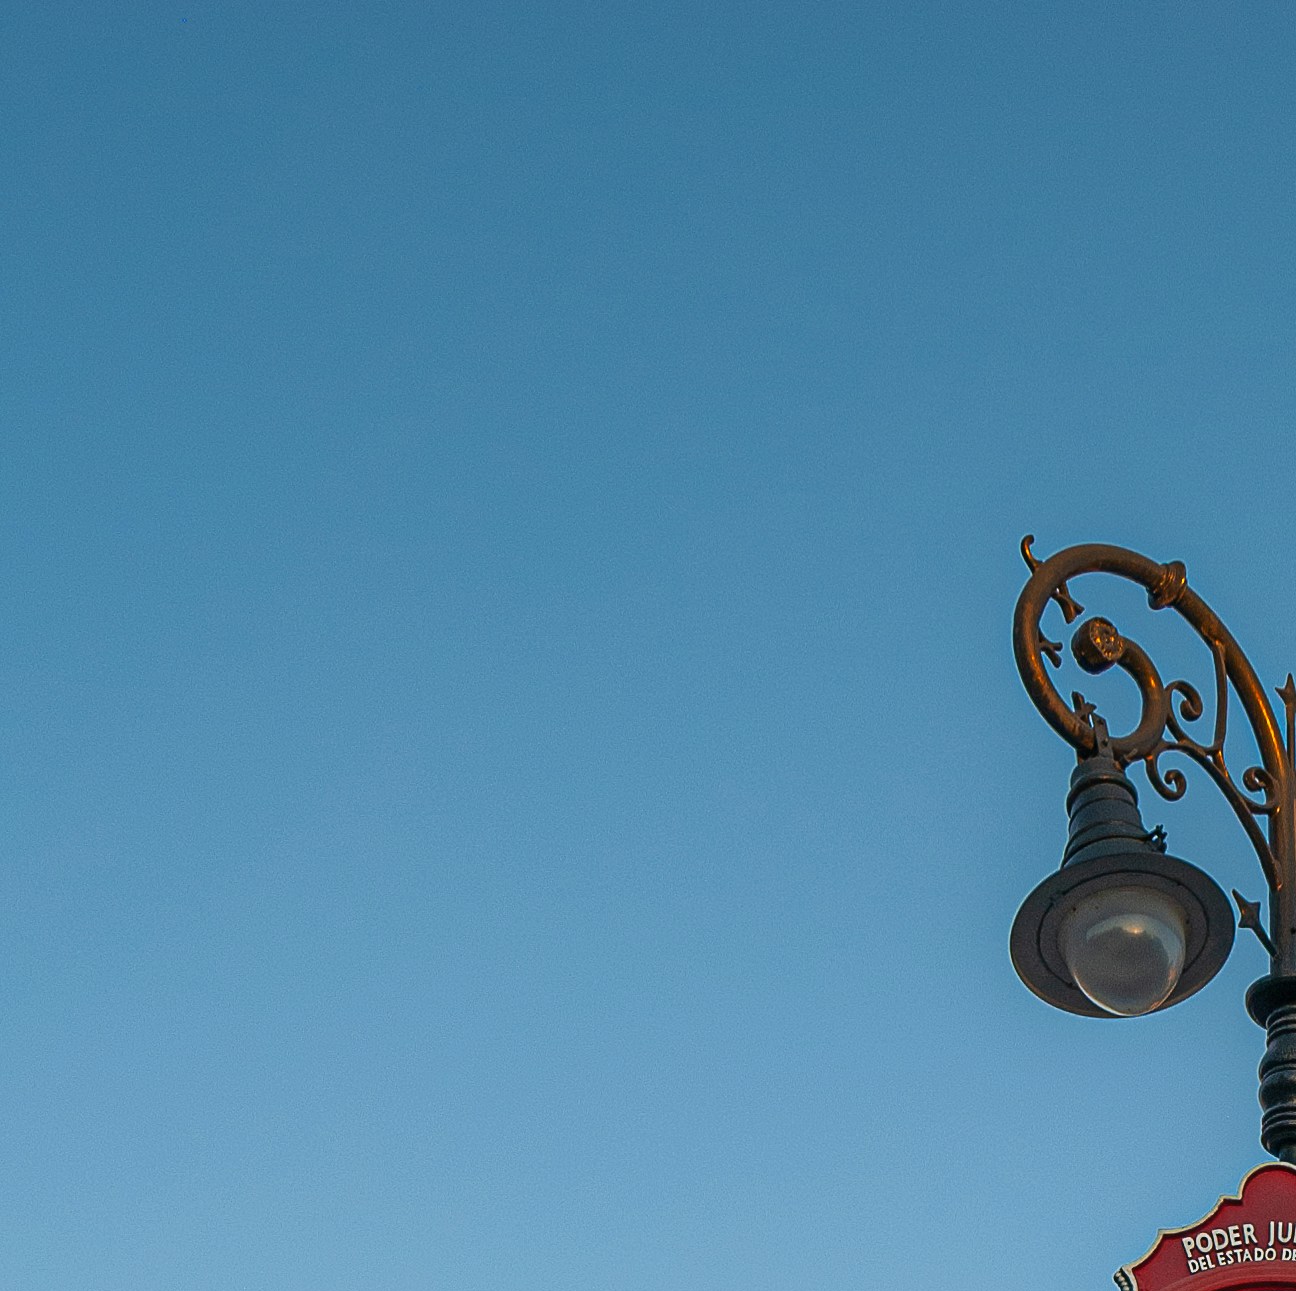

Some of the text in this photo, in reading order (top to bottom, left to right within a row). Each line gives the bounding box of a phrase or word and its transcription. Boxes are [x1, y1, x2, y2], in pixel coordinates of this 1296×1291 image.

[1181, 1222, 1257, 1259] PODER
[1187, 1255, 1216, 1275] DEL
[1216, 1246, 1277, 1268] ESTADO
